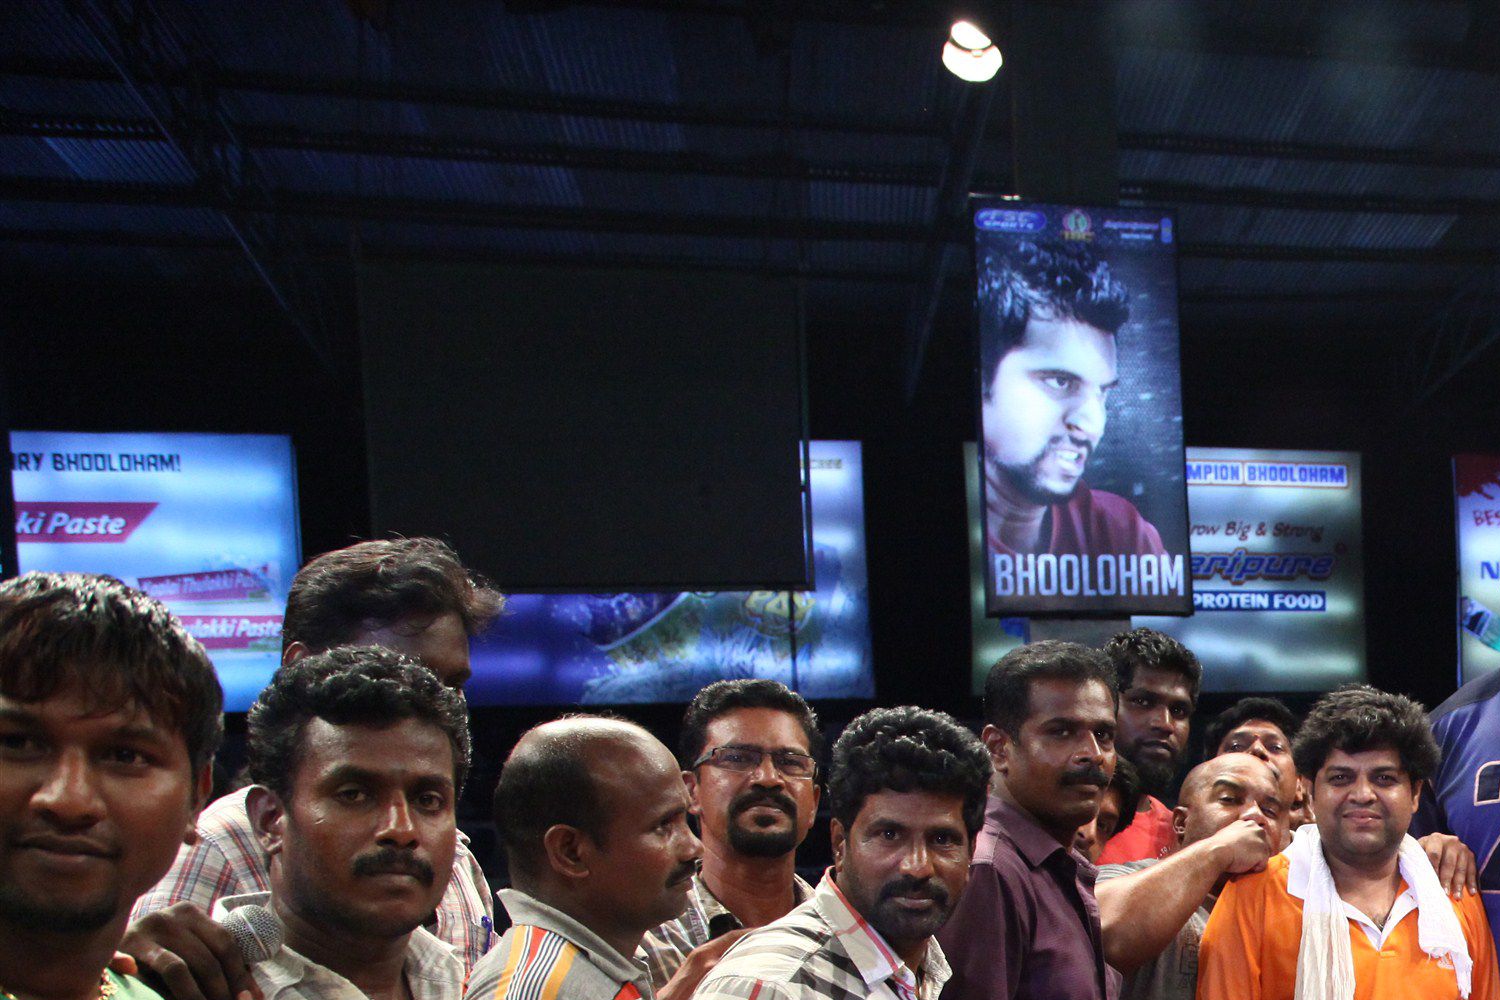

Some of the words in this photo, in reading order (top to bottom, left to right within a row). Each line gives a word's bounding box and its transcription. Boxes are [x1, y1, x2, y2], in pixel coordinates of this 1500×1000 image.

[1247, 465, 1345, 483] BHOOLOHAM
[47, 512, 127, 535] Paste
[1224, 521, 1251, 541] Big
[1255, 522, 1267, 536] &
[1272, 523, 1325, 542] Strong
[994, 553, 1185, 598] BHOOLOHAM
[1273, 593, 1324, 609] FOOD
